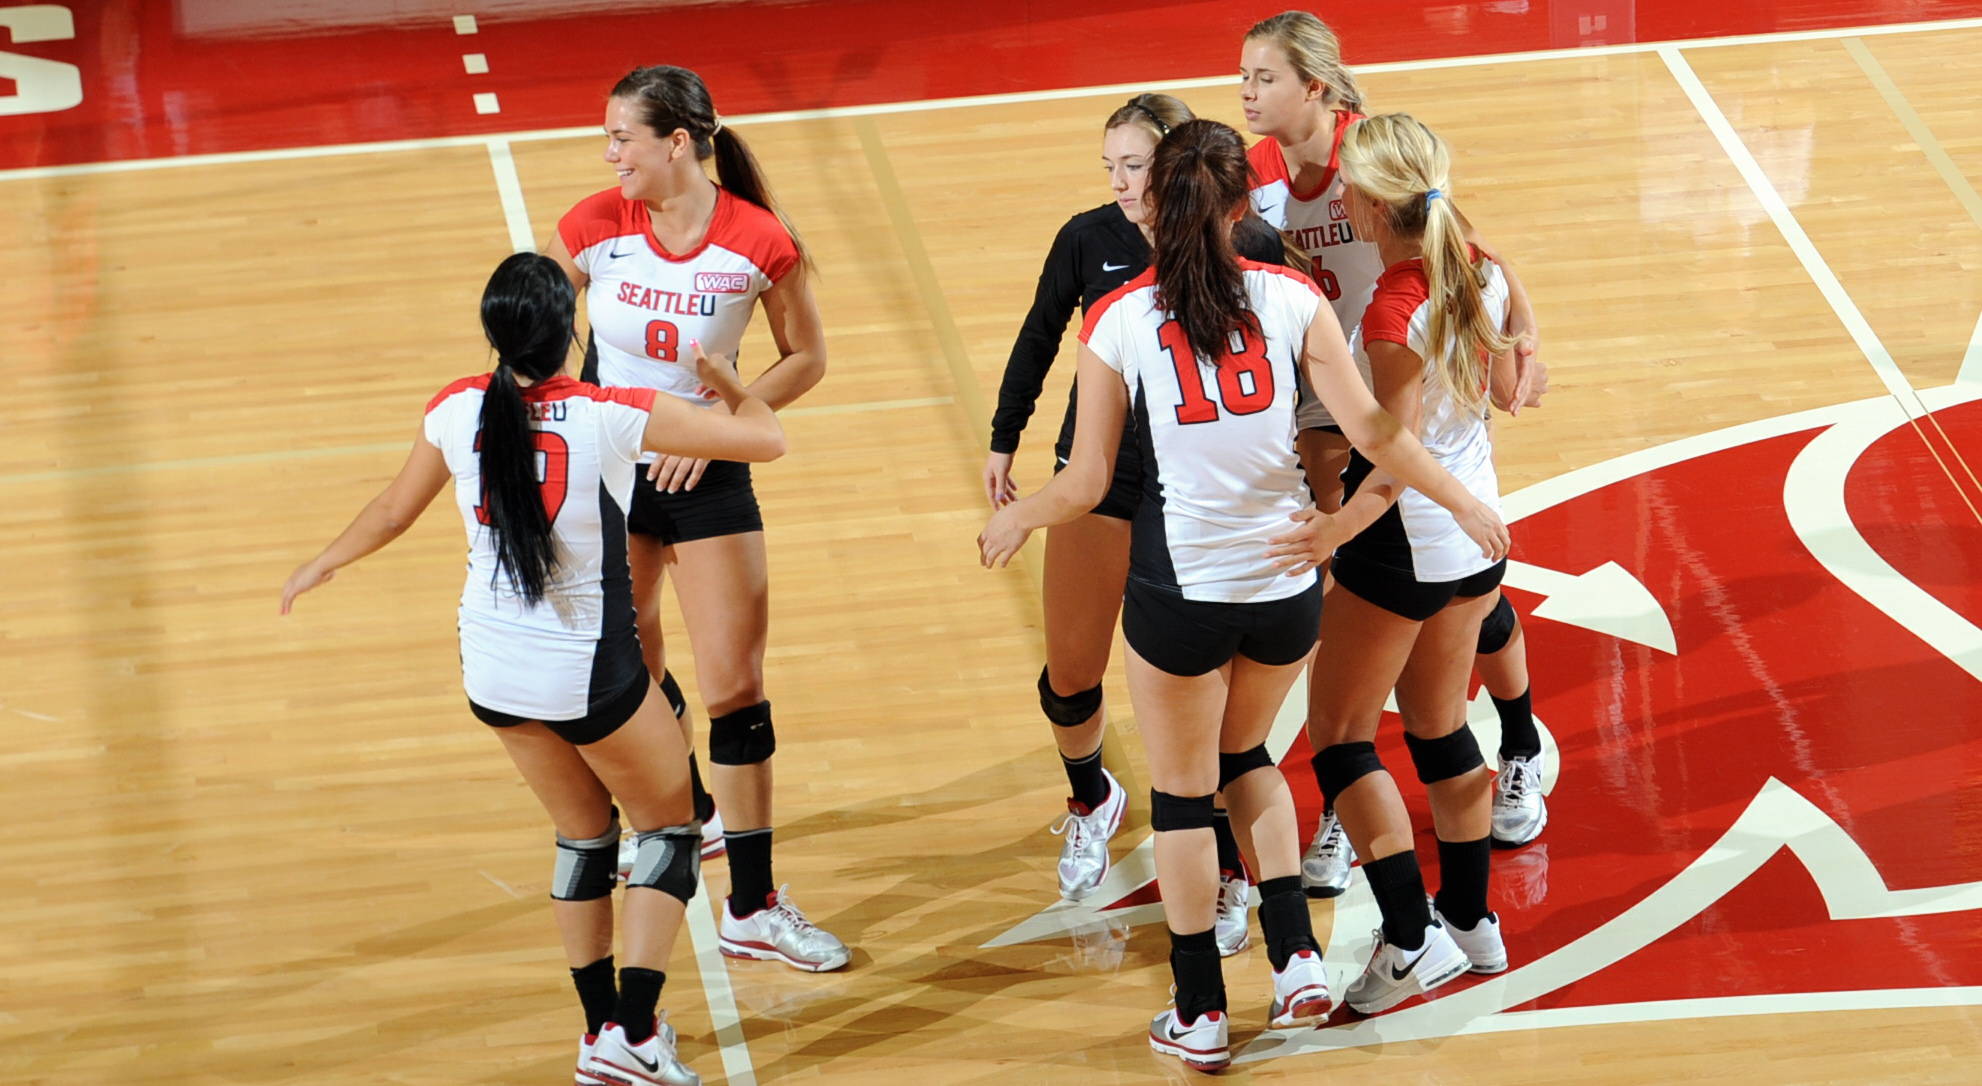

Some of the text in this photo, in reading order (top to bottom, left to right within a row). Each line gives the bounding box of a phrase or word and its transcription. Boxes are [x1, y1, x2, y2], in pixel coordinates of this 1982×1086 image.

[701, 275, 745, 290] WAC
[1311, 255, 1342, 301] 6
[645, 319, 679, 363] 8
[1157, 309, 1275, 425] 18
